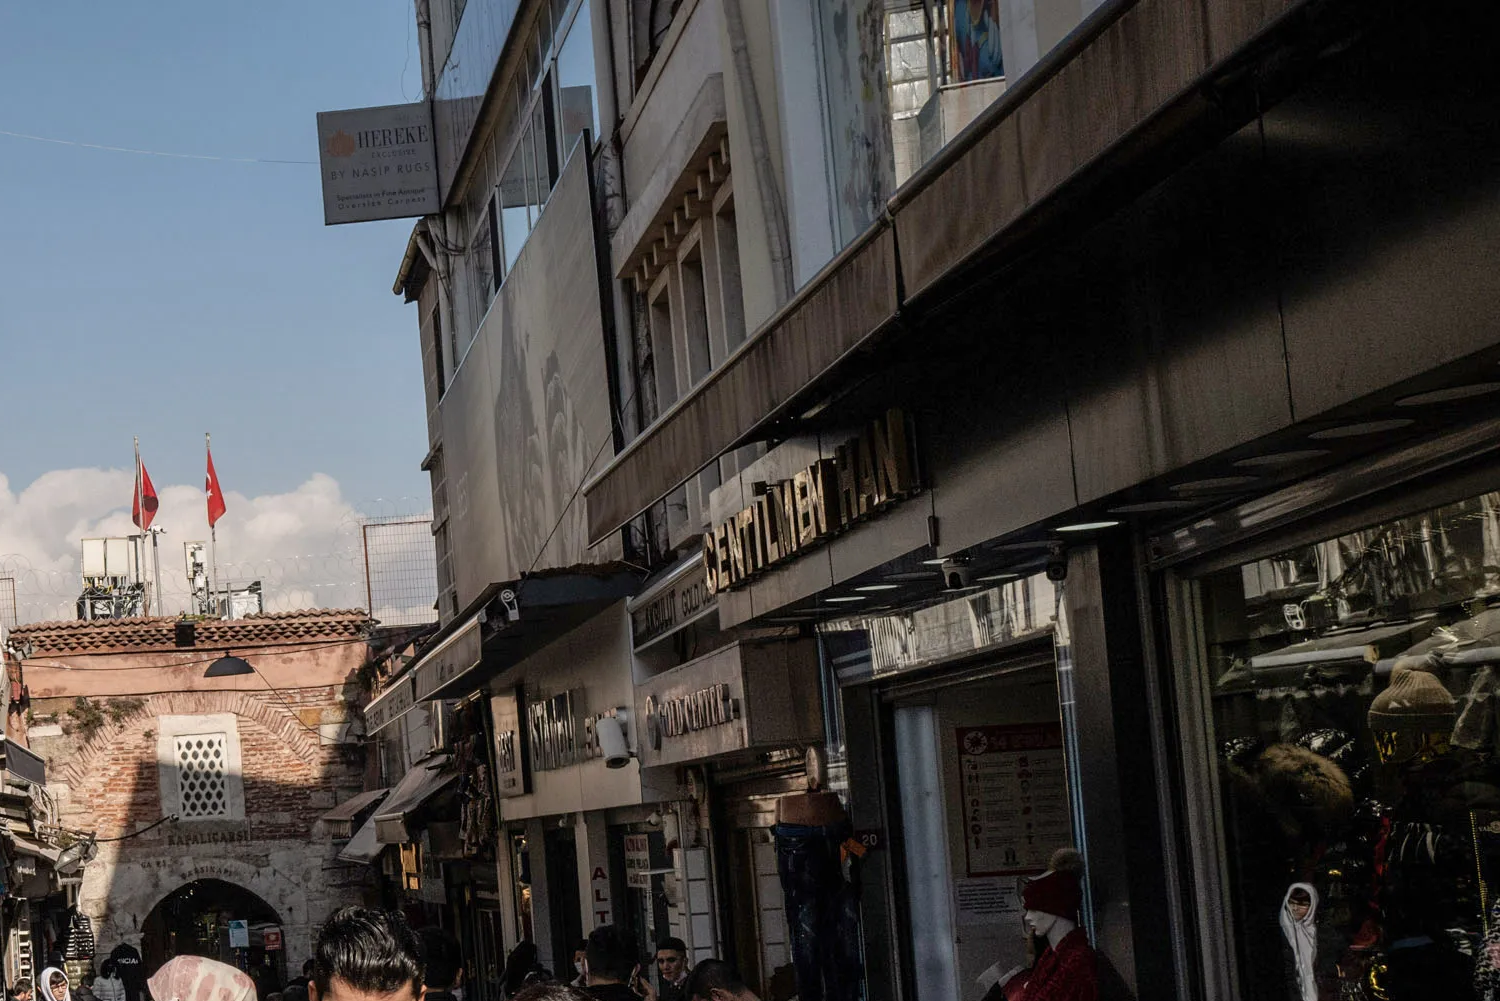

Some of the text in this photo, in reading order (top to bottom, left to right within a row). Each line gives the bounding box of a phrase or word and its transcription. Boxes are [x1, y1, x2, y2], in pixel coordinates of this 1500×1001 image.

[357, 125, 428, 148] HEREKE
[330, 170, 345, 181] BY
[397, 161, 431, 174] RUGS
[381, 189, 397, 198] Fine
[684, 683, 728, 733] CENTER
[862, 833, 878, 847] 20
